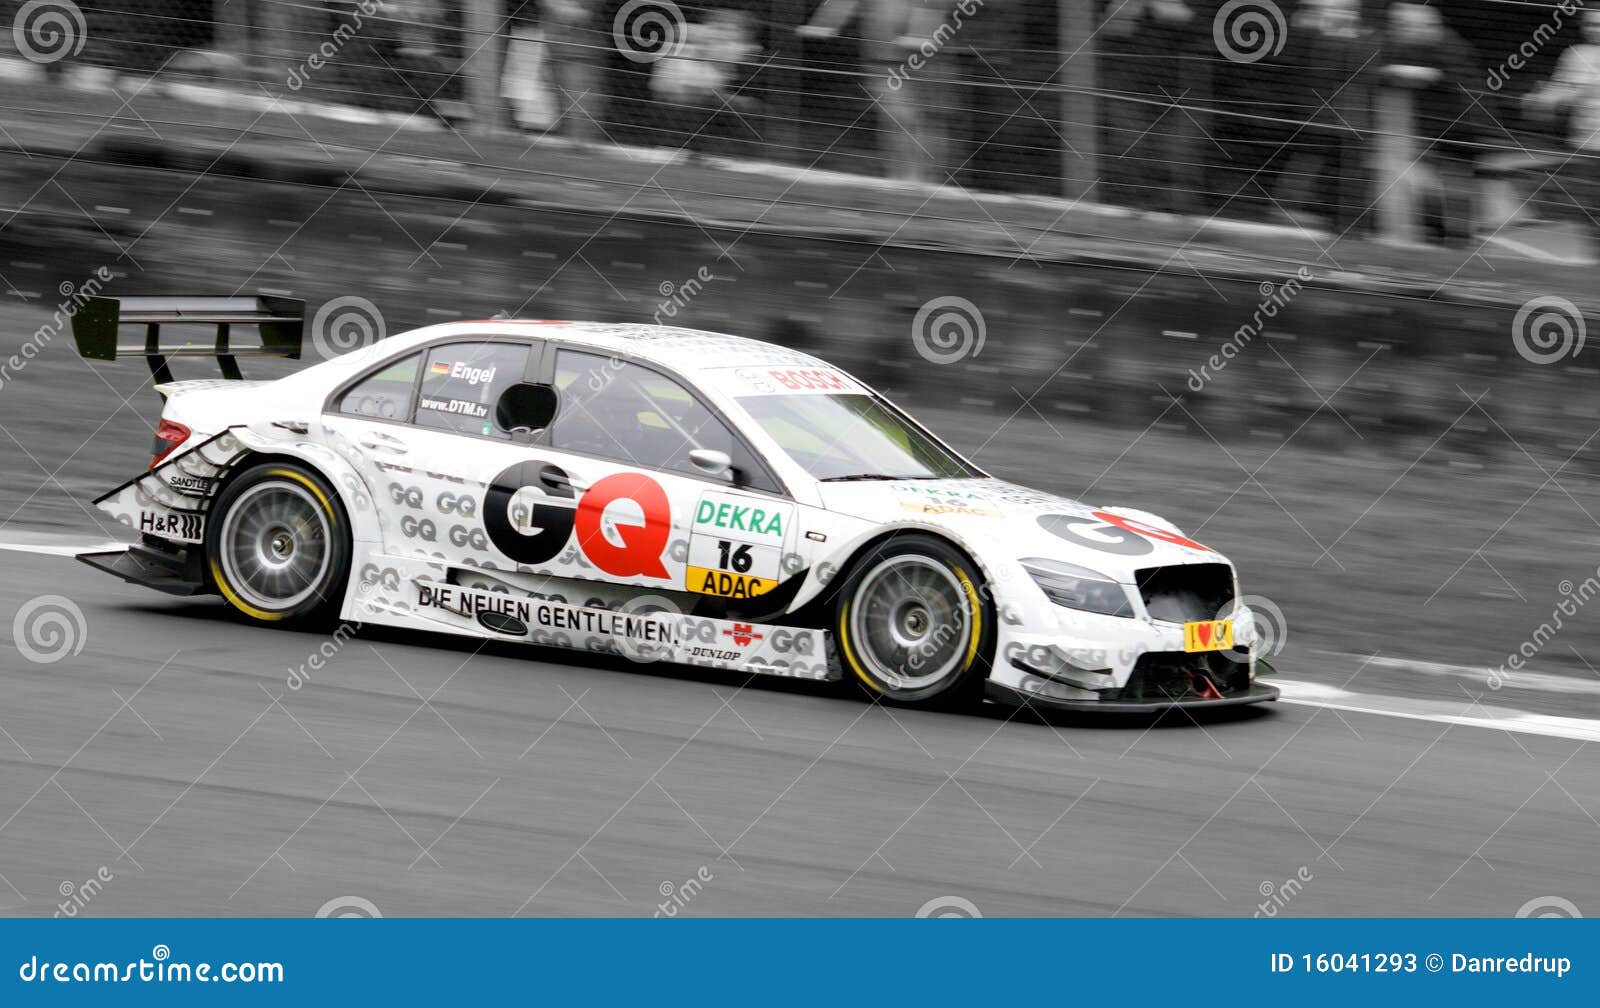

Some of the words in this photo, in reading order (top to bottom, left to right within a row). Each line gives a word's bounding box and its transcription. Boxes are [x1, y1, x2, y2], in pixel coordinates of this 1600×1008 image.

[451, 362, 497, 385] Engel
[421, 399, 488, 417] www.DTM.tv
[389, 482, 424, 510] GQ
[436, 491, 477, 519] GQ
[141, 511, 178, 534] H&R
[401, 515, 437, 542] GQ
[483, 460, 672, 580] GQ
[696, 500, 783, 537] DEKRA
[449, 524, 489, 551] GQ
[717, 540, 754, 573] 16
[702, 571, 761, 599] ADAC
[417, 586, 452, 609] DIE
[537, 605, 679, 645] GENTLEMEN.
[677, 617, 717, 644] GQ
[770, 629, 815, 657] GQ
[692, 647, 741, 661] DUNLOP
